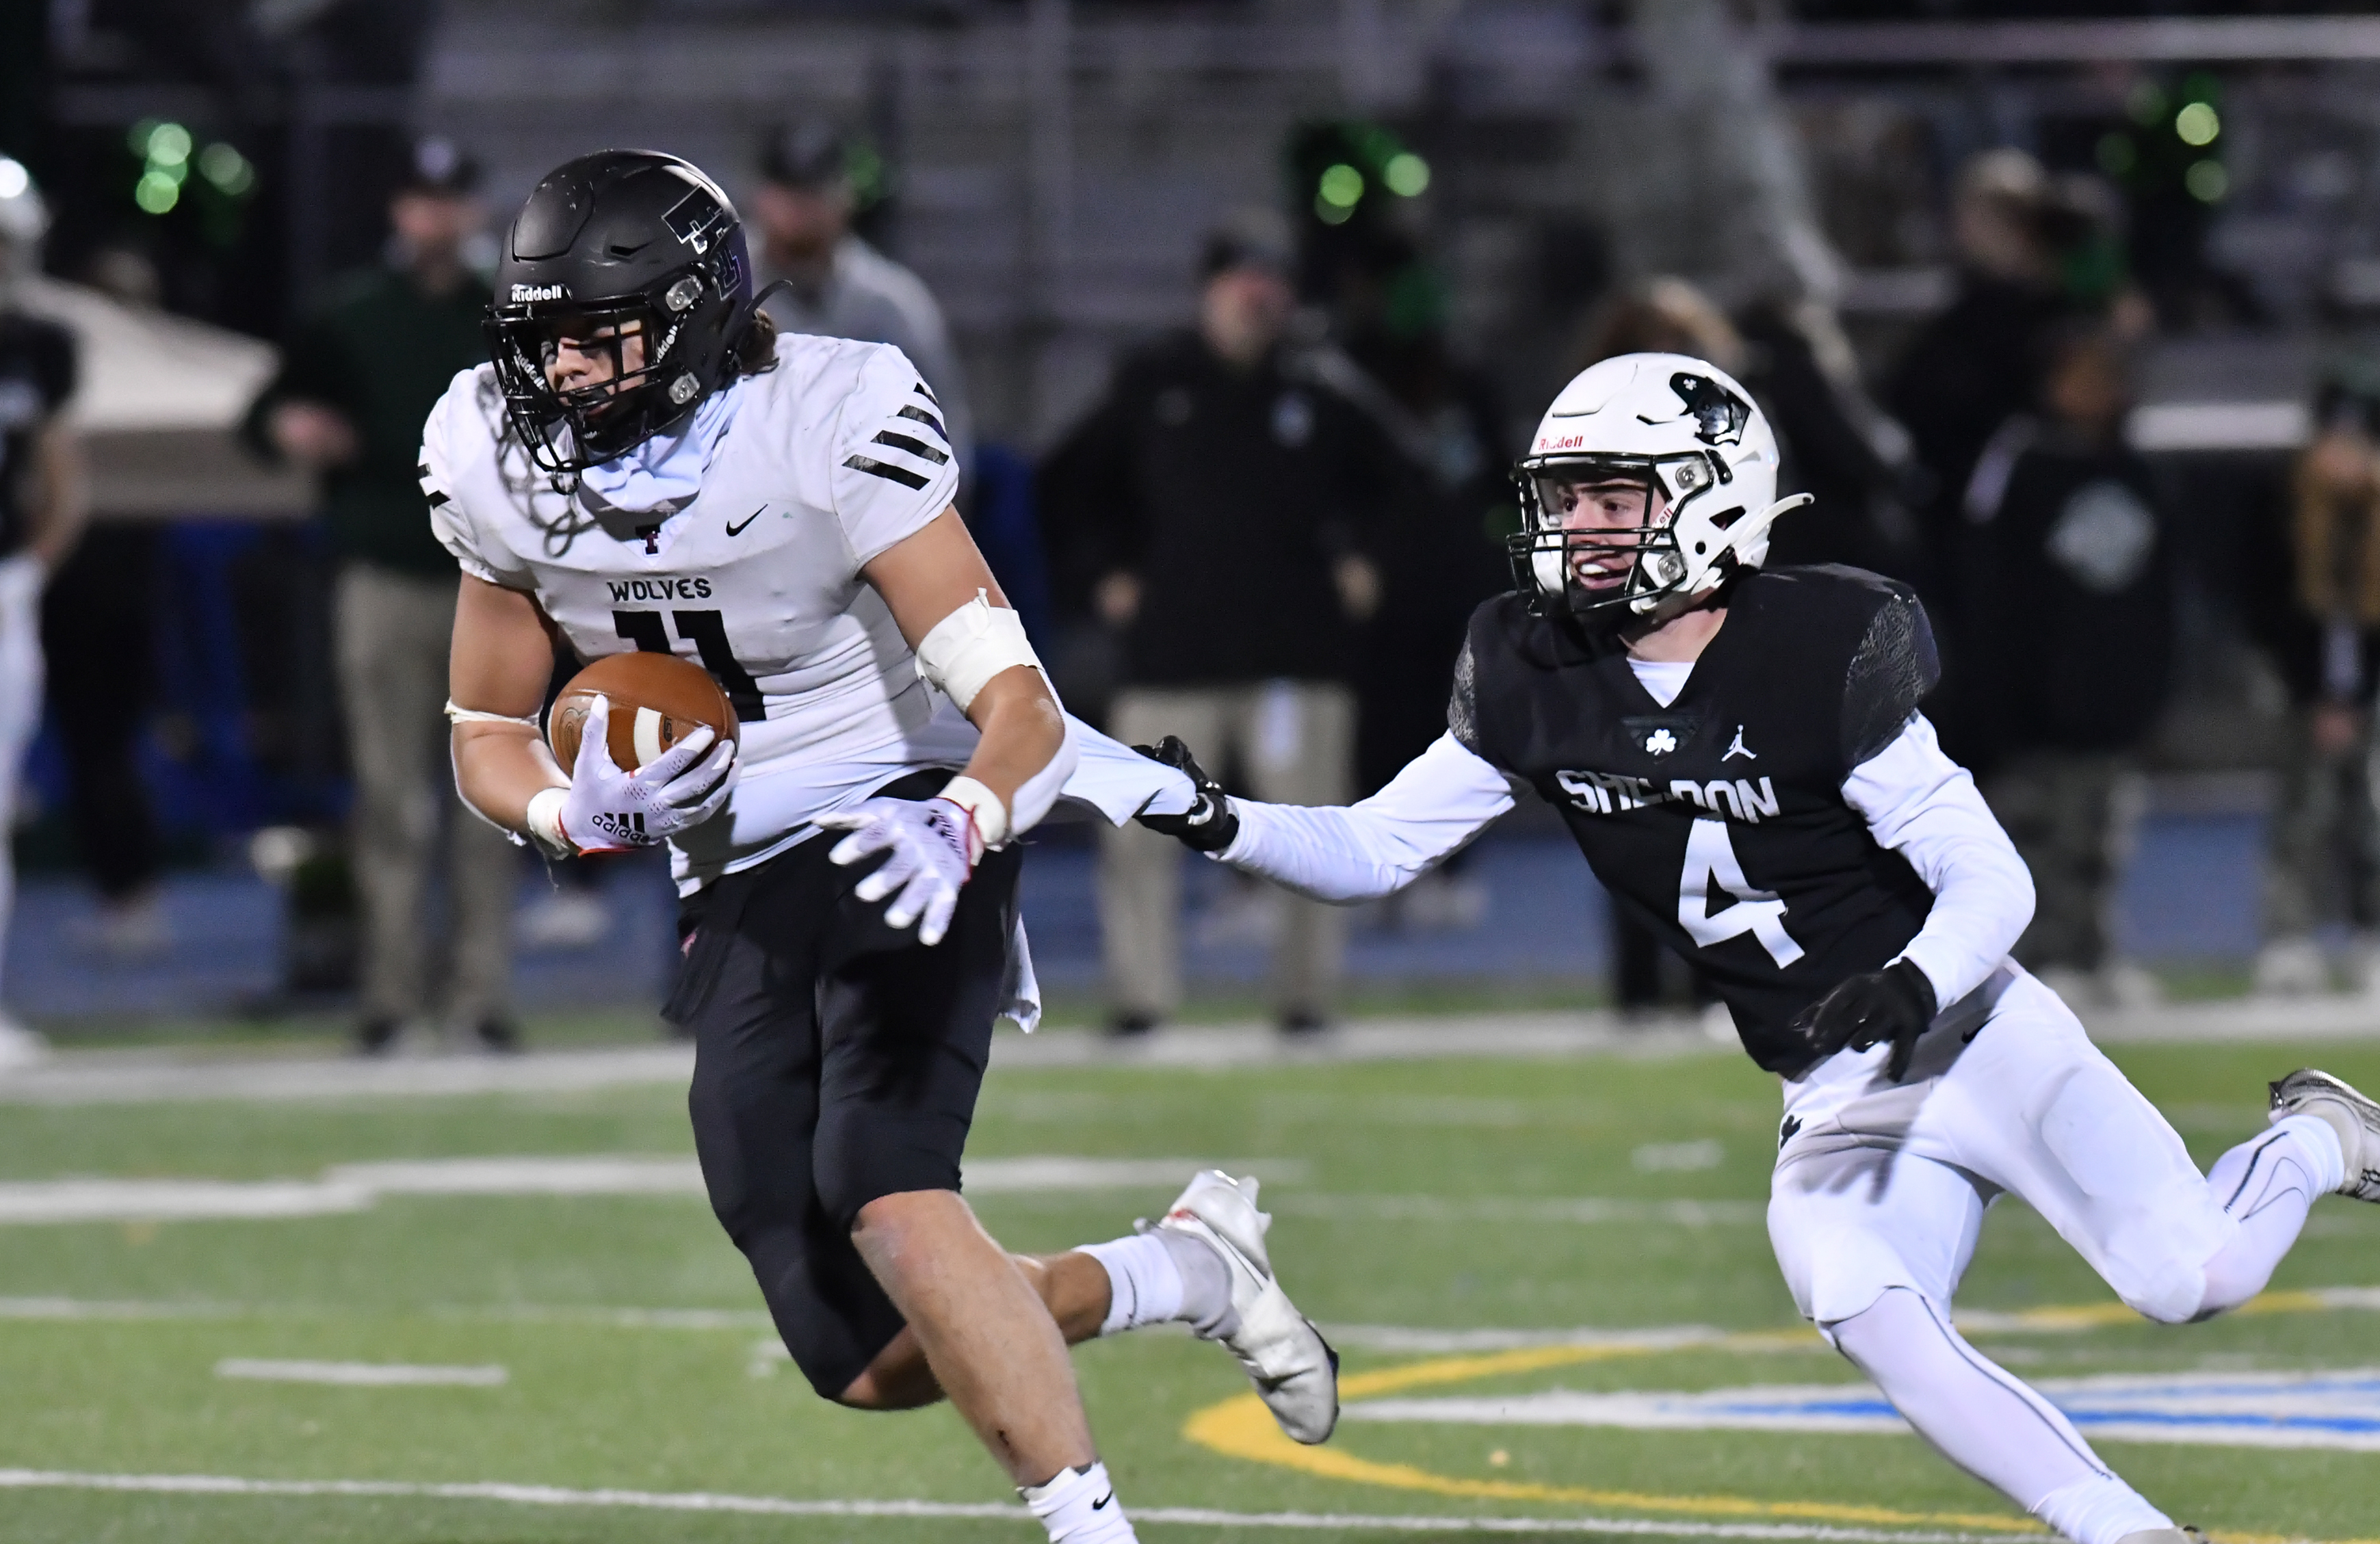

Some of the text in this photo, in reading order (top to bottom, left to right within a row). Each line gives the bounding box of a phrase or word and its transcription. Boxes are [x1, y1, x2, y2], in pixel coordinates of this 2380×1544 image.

[512, 284, 562, 302] Riddell
[651, 325, 678, 366] iddell
[606, 578, 712, 601] WOLVES
[592, 814, 651, 843] adidas
[1678, 810, 1806, 970] 4
